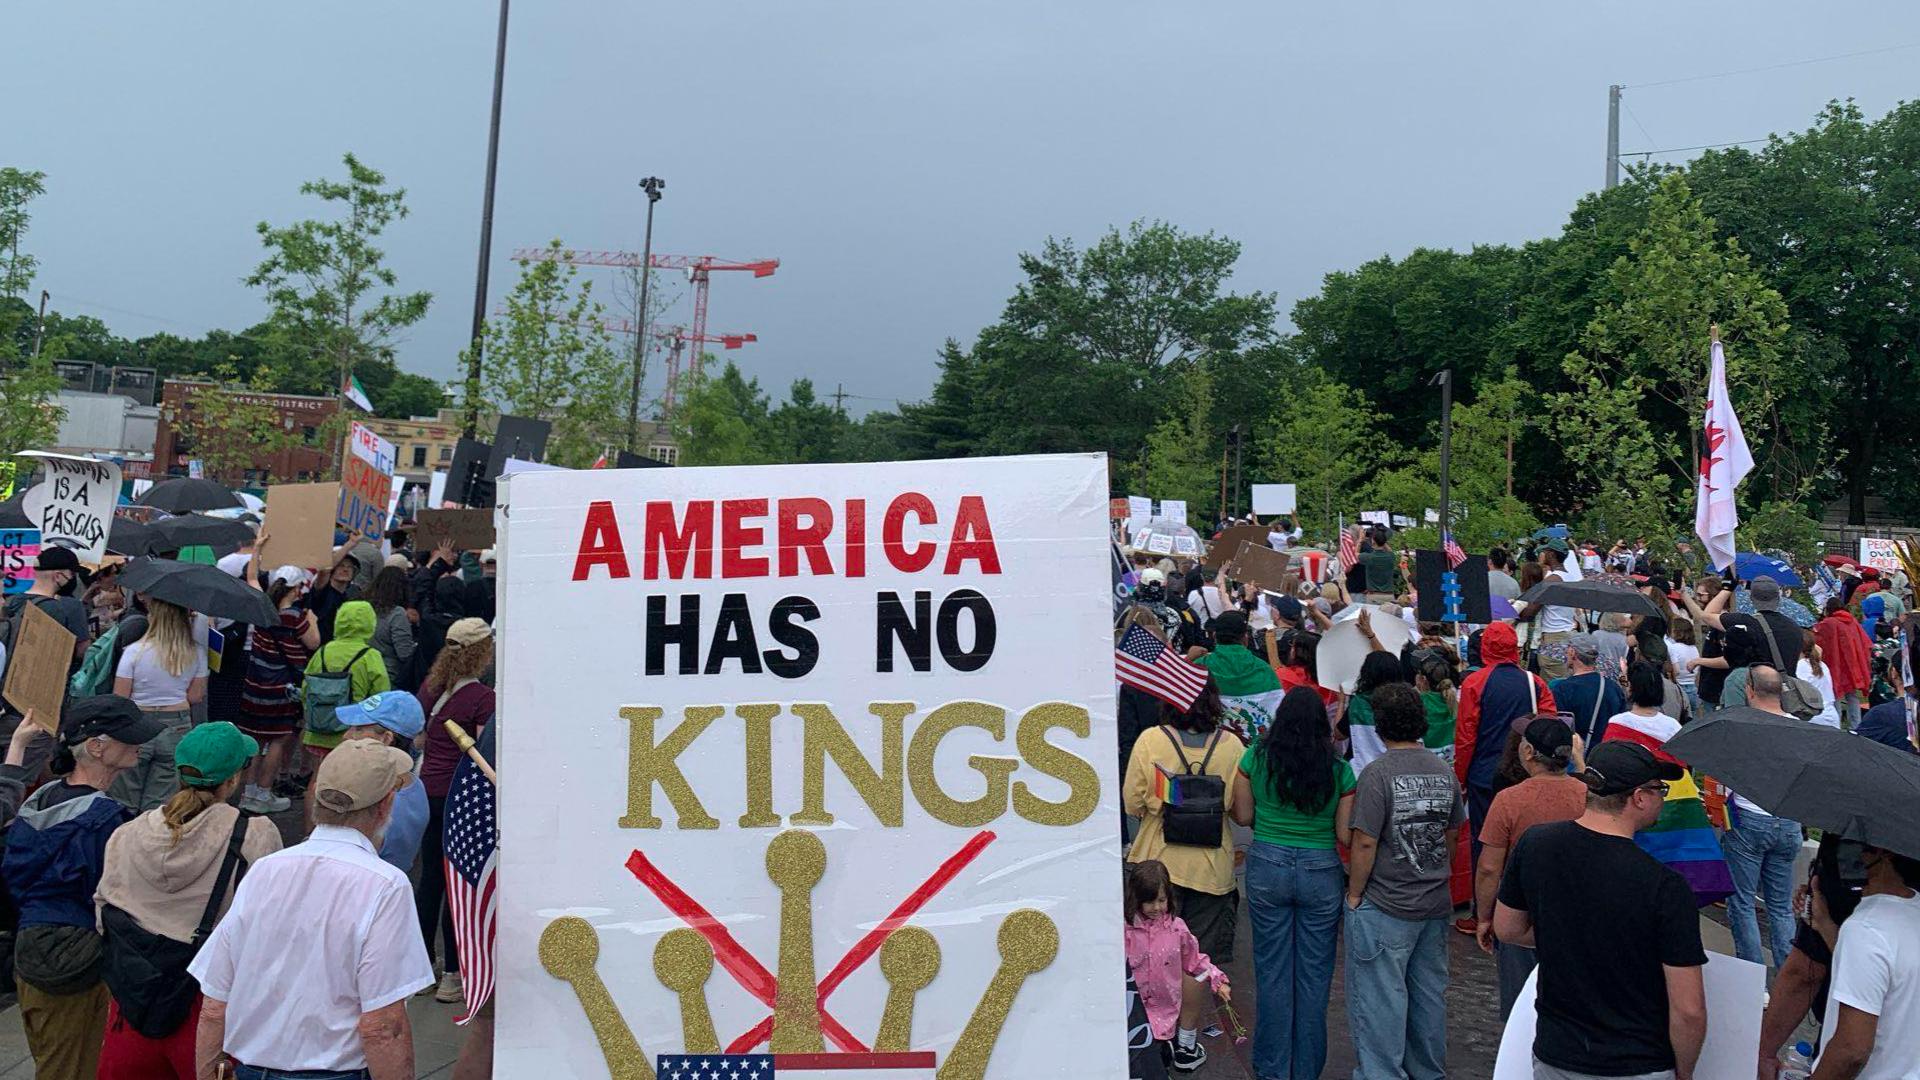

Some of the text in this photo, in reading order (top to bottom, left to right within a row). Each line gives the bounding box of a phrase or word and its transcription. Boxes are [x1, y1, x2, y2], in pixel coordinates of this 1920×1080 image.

[352, 422, 379, 452] FIRE
[345, 456, 391, 510] SAVE
[375, 450, 393, 477] ICE
[54, 476, 89, 506] IS A
[338, 487, 385, 541] LIVES
[42, 504, 104, 548] FASCIST
[572, 491, 1002, 581] AMERICA
[645, 588, 997, 679] HAS NO
[617, 700, 1101, 829] KINGS
[1394, 775, 1420, 790] KEY
